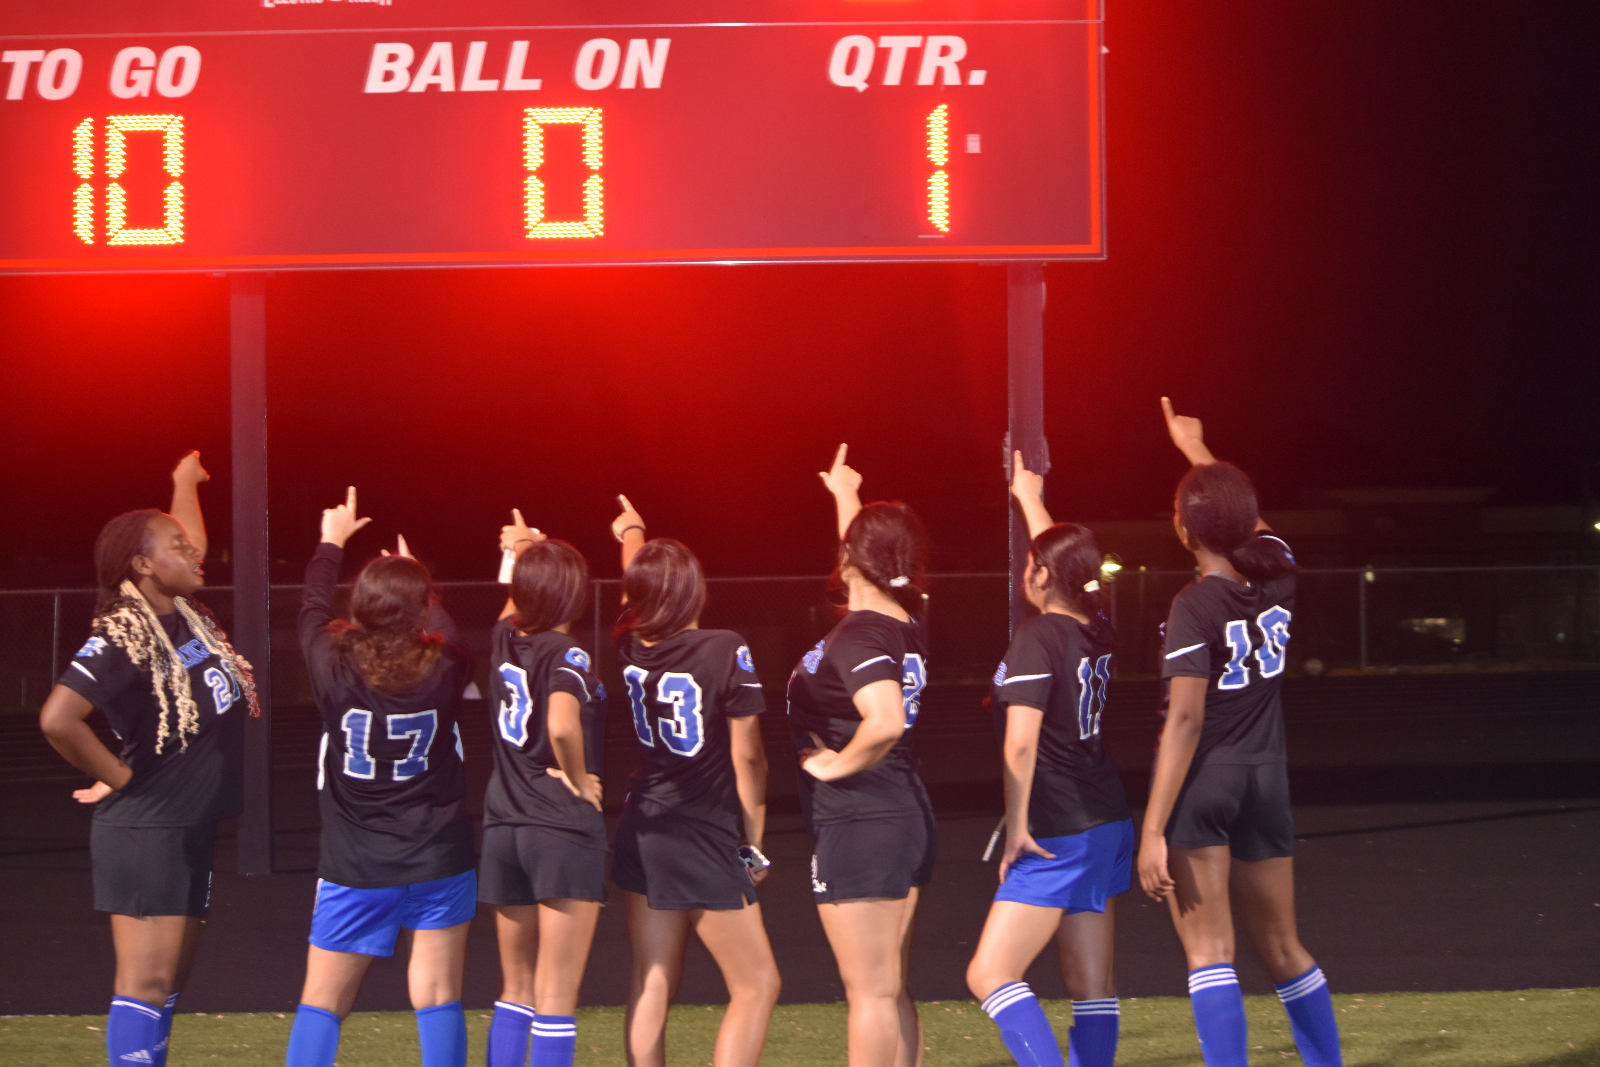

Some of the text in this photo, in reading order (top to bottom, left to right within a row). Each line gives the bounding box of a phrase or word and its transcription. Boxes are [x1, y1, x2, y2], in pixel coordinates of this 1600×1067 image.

[1, 46, 202, 101] TO GO
[364, 38, 672, 94] BALL ON
[828, 34, 988, 93] QTR.
[72, 114, 185, 246] 10
[522, 106, 605, 240] 0
[925, 103, 950, 233] 1
[341, 708, 438, 781] 17
[498, 662, 533, 747] 3
[623, 665, 705, 757] 13
